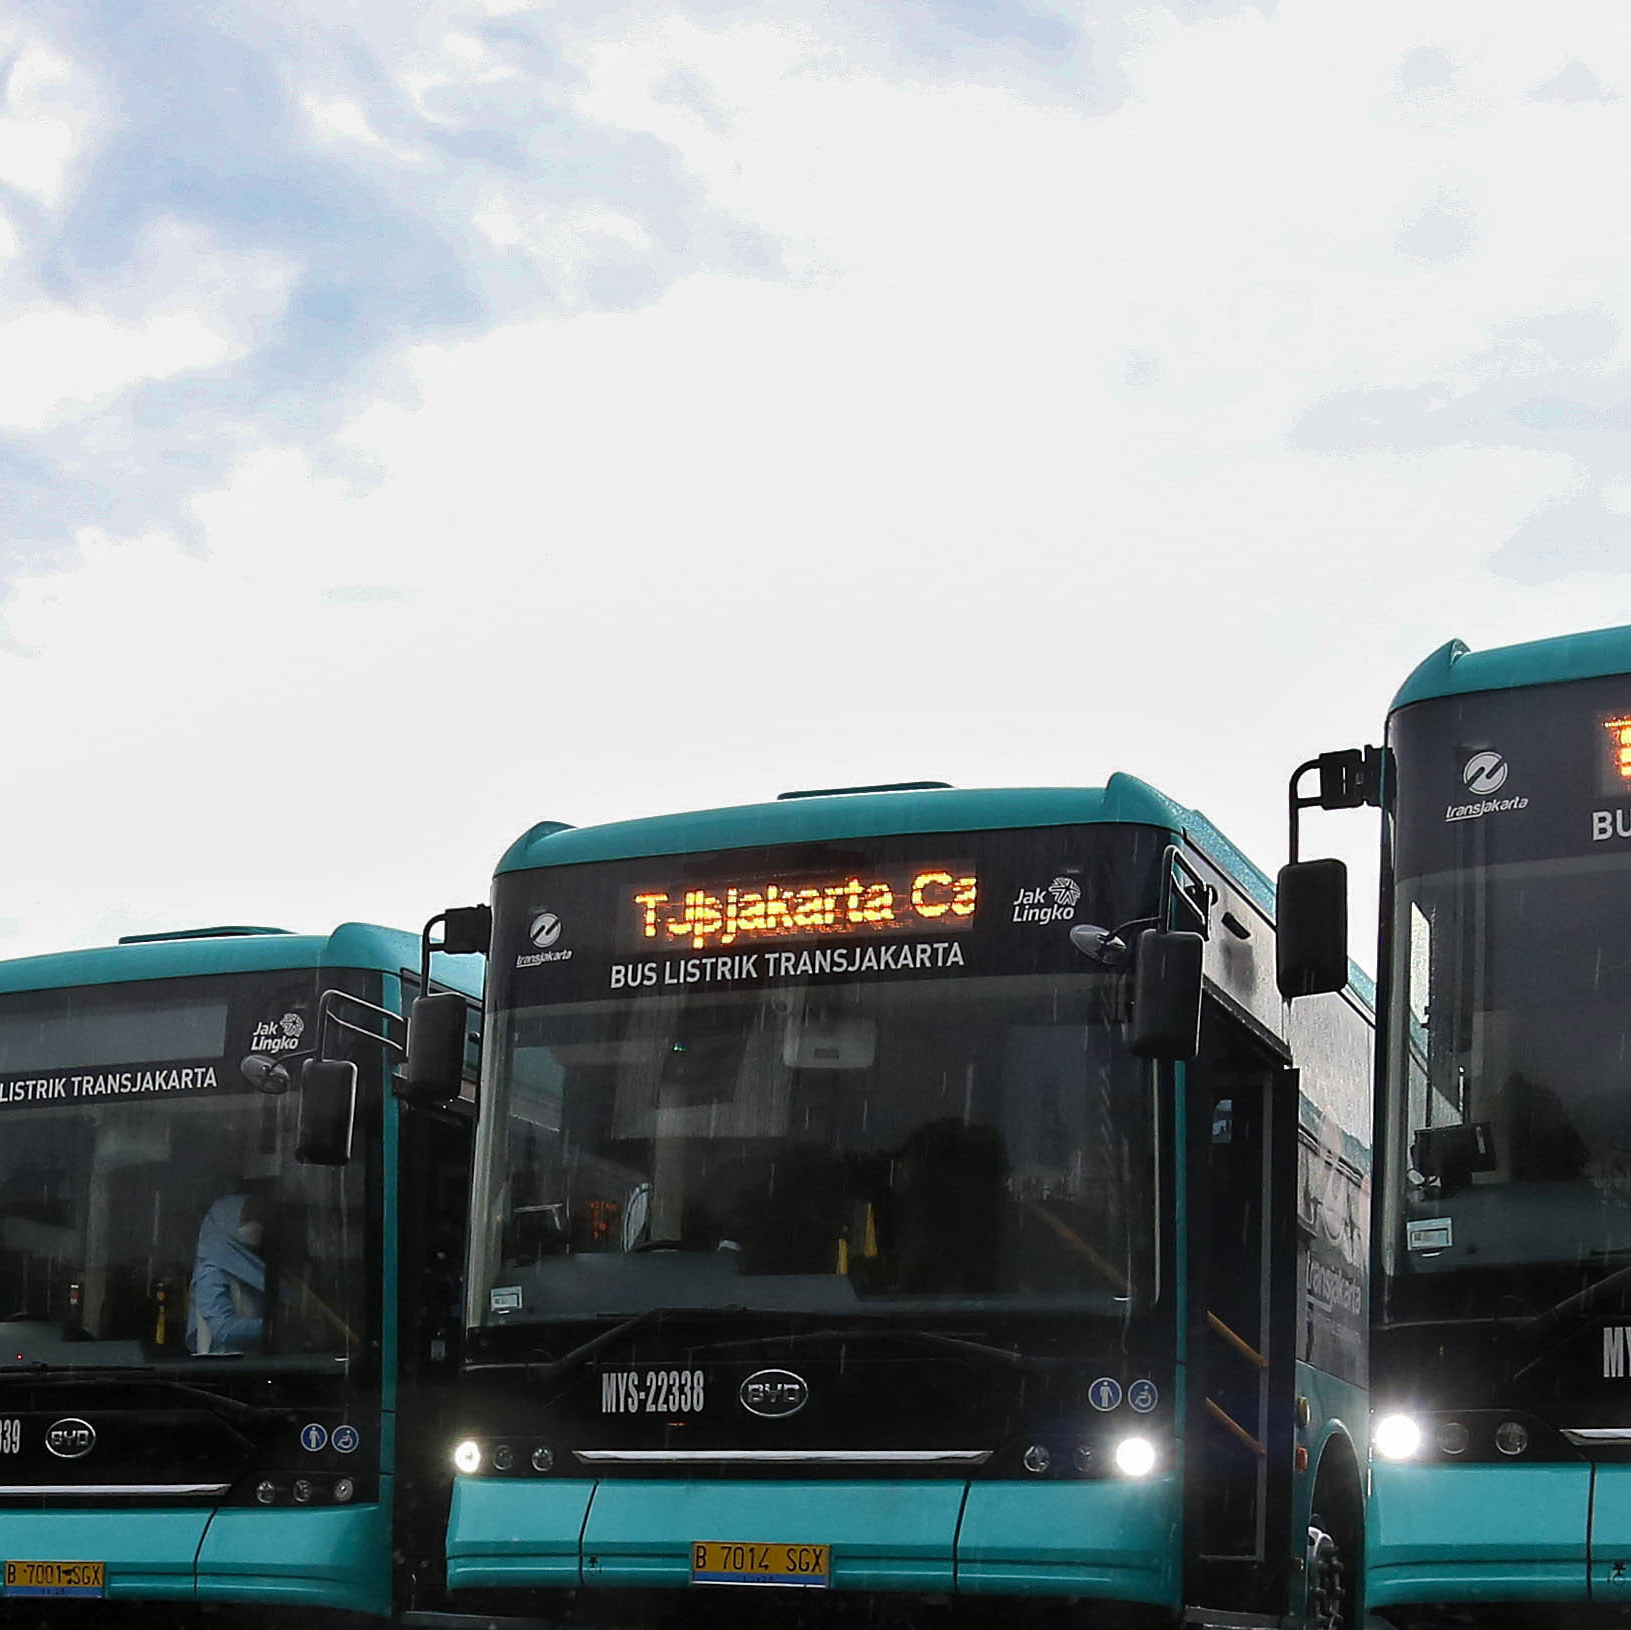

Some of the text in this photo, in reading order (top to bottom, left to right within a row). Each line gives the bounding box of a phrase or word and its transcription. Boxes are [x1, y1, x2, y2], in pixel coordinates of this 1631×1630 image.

[1445, 796, 1530, 822] transjakarta
[1013, 887, 1048, 906] Jak
[1012, 902, 1075, 925] Lingko
[610, 942, 965, 989] BUS LISTRIK TRANSJAKARTA
[252, 1021, 279, 1036] Jak
[251, 1034, 299, 1053] Lingko
[71, 1066, 218, 1097] TRANSJAKARTA
[601, 1370, 705, 1413] MYS-22338
[747, 1383, 801, 1403] BYD
[51, 1429, 90, 1446] BYD
[695, 1545, 823, 1573] B 7014 SGX
[7, 1564, 101, 1585] B 7001 SGX
